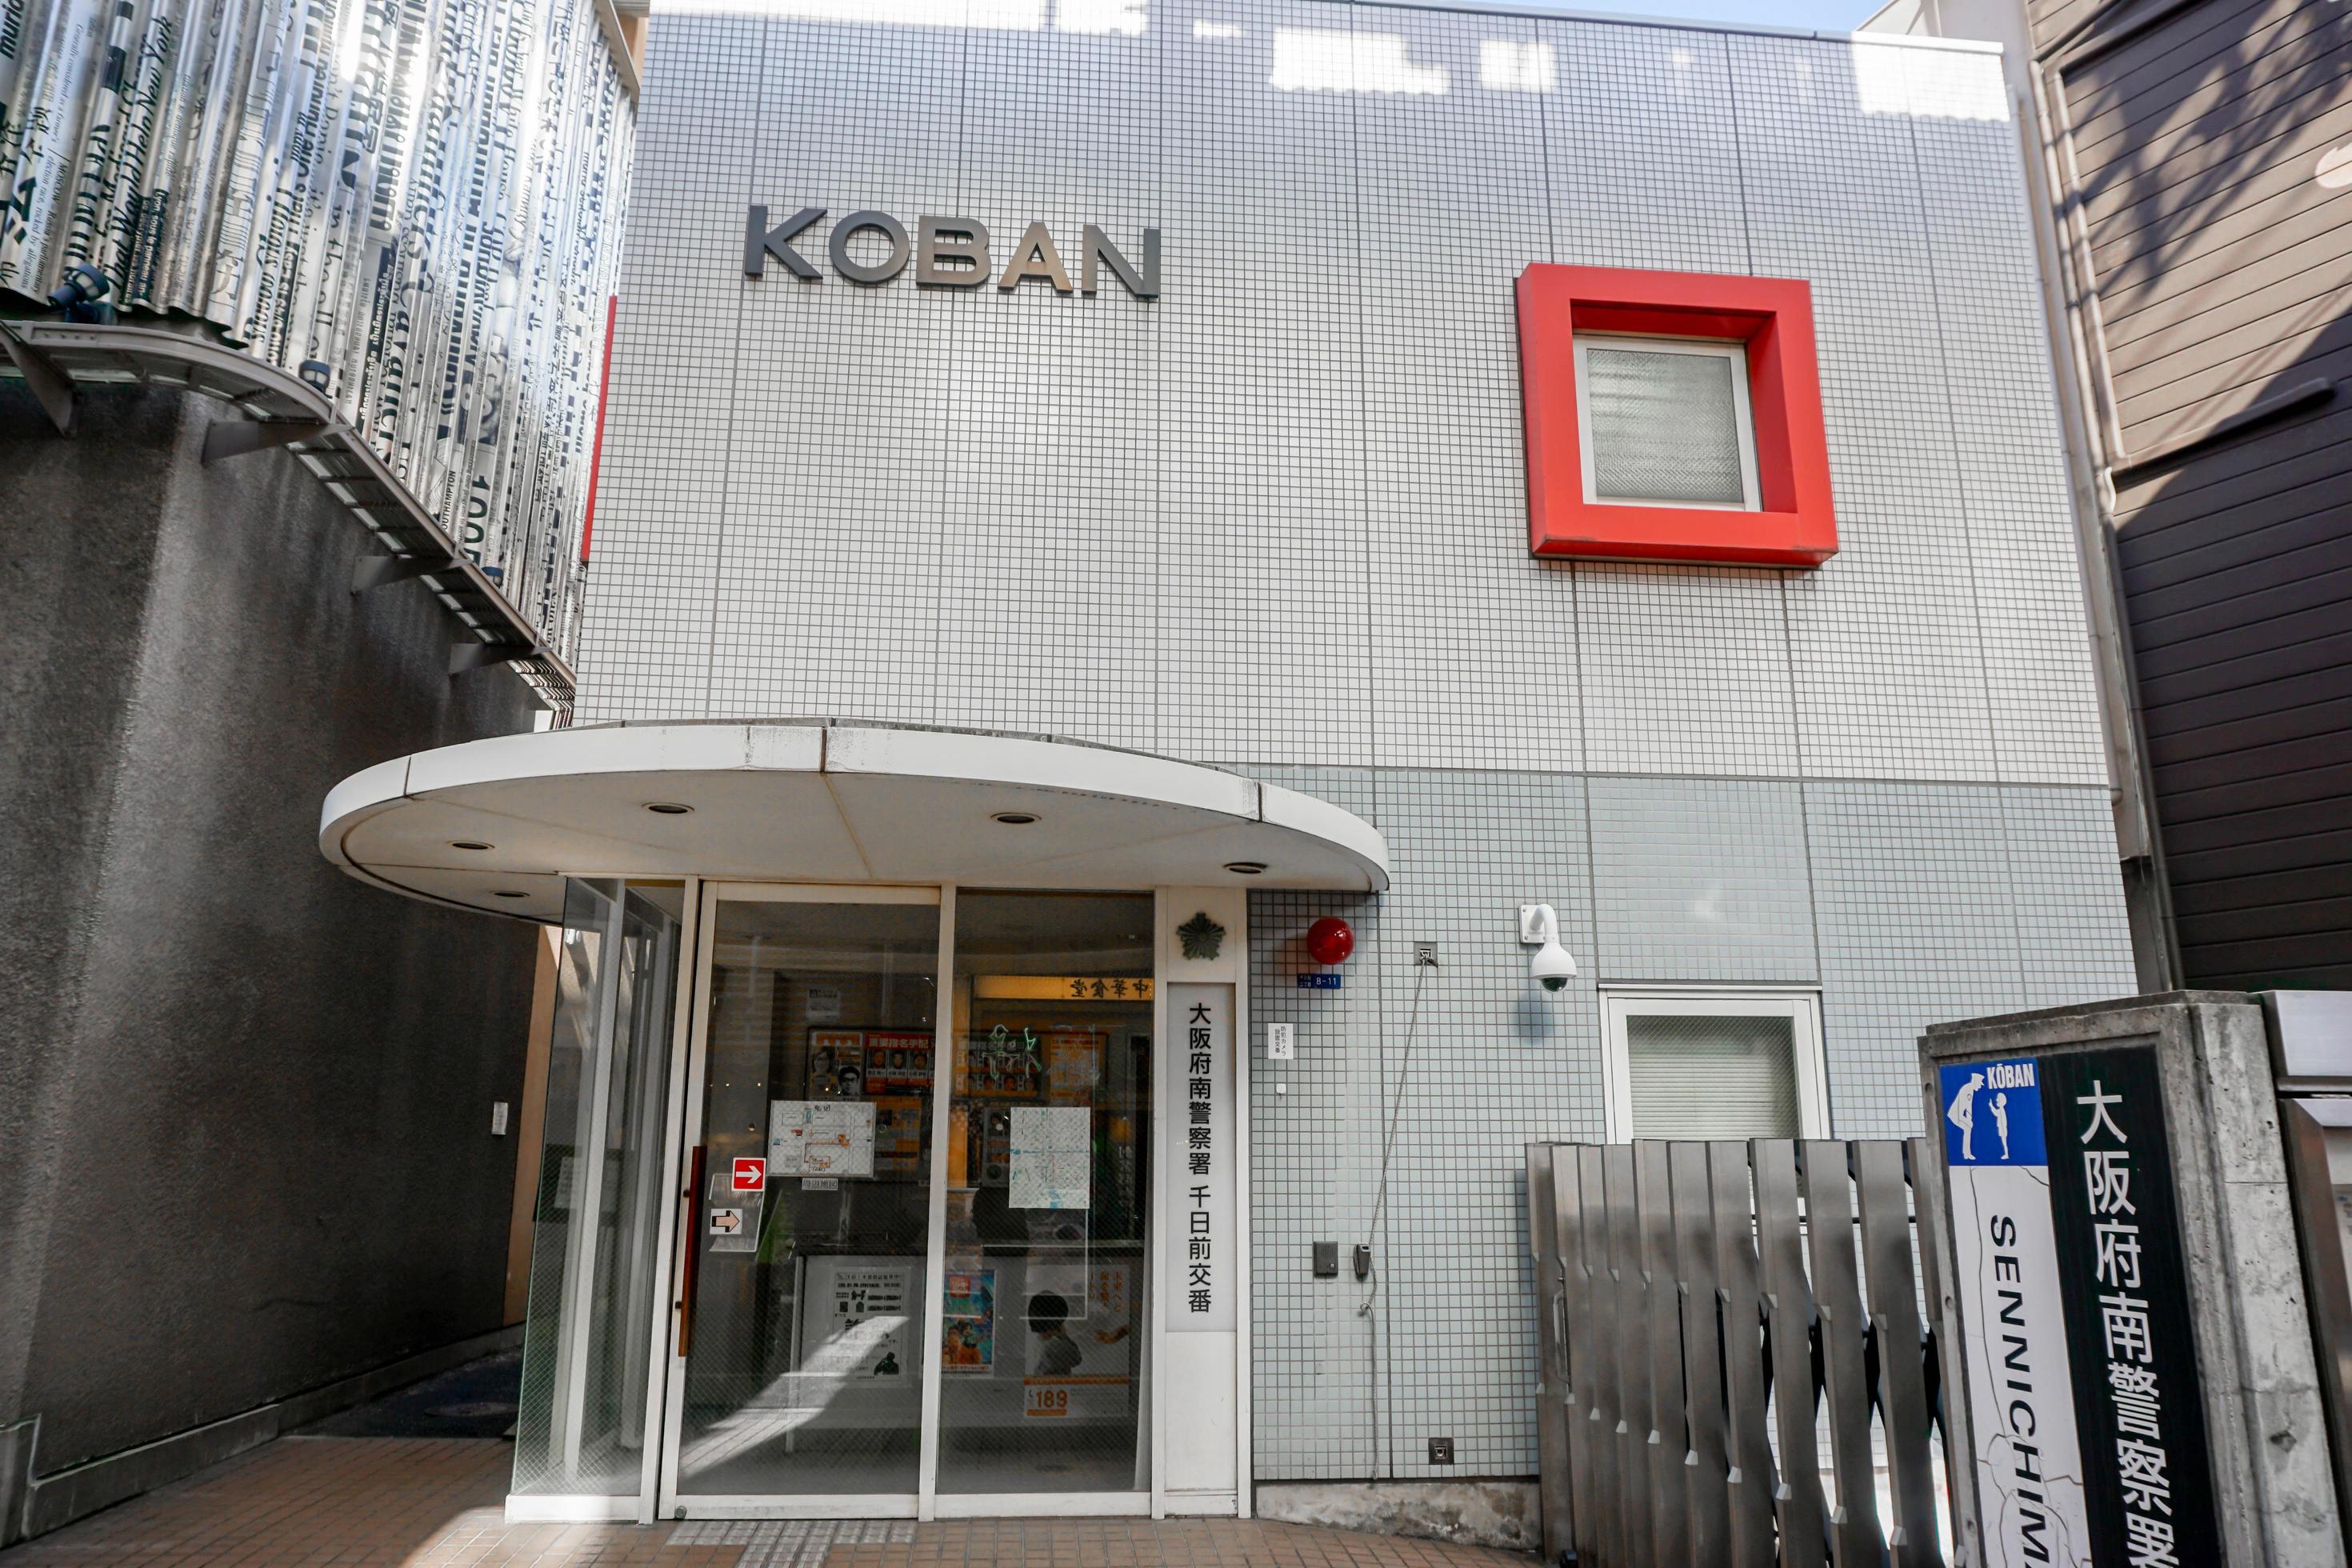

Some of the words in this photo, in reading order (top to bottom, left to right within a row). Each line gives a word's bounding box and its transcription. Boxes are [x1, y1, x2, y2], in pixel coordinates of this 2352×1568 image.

[145, 15, 172, 64] York
[134, 67, 161, 116] New
[41, 155, 55, 185] election
[51, 162, 67, 202] MOSCOW
[30, 206, 44, 233] rocked
[148, 214, 159, 237] sous
[20, 247, 38, 289] allegations
[140, 244, 154, 281] panneau
[744, 205, 1162, 298] KOBAN
[1316, 977, 1337, 986] 8-11
[1188, 1002, 1212, 1175] 大阪府南警察署
[1986, 1062, 2035, 1090] KŌBAN
[1188, 1185, 1212, 1313] 千日前交番
[1036, 1390, 1068, 1408] 189
[1990, 1214, 2050, 1568] SENNICHIM
